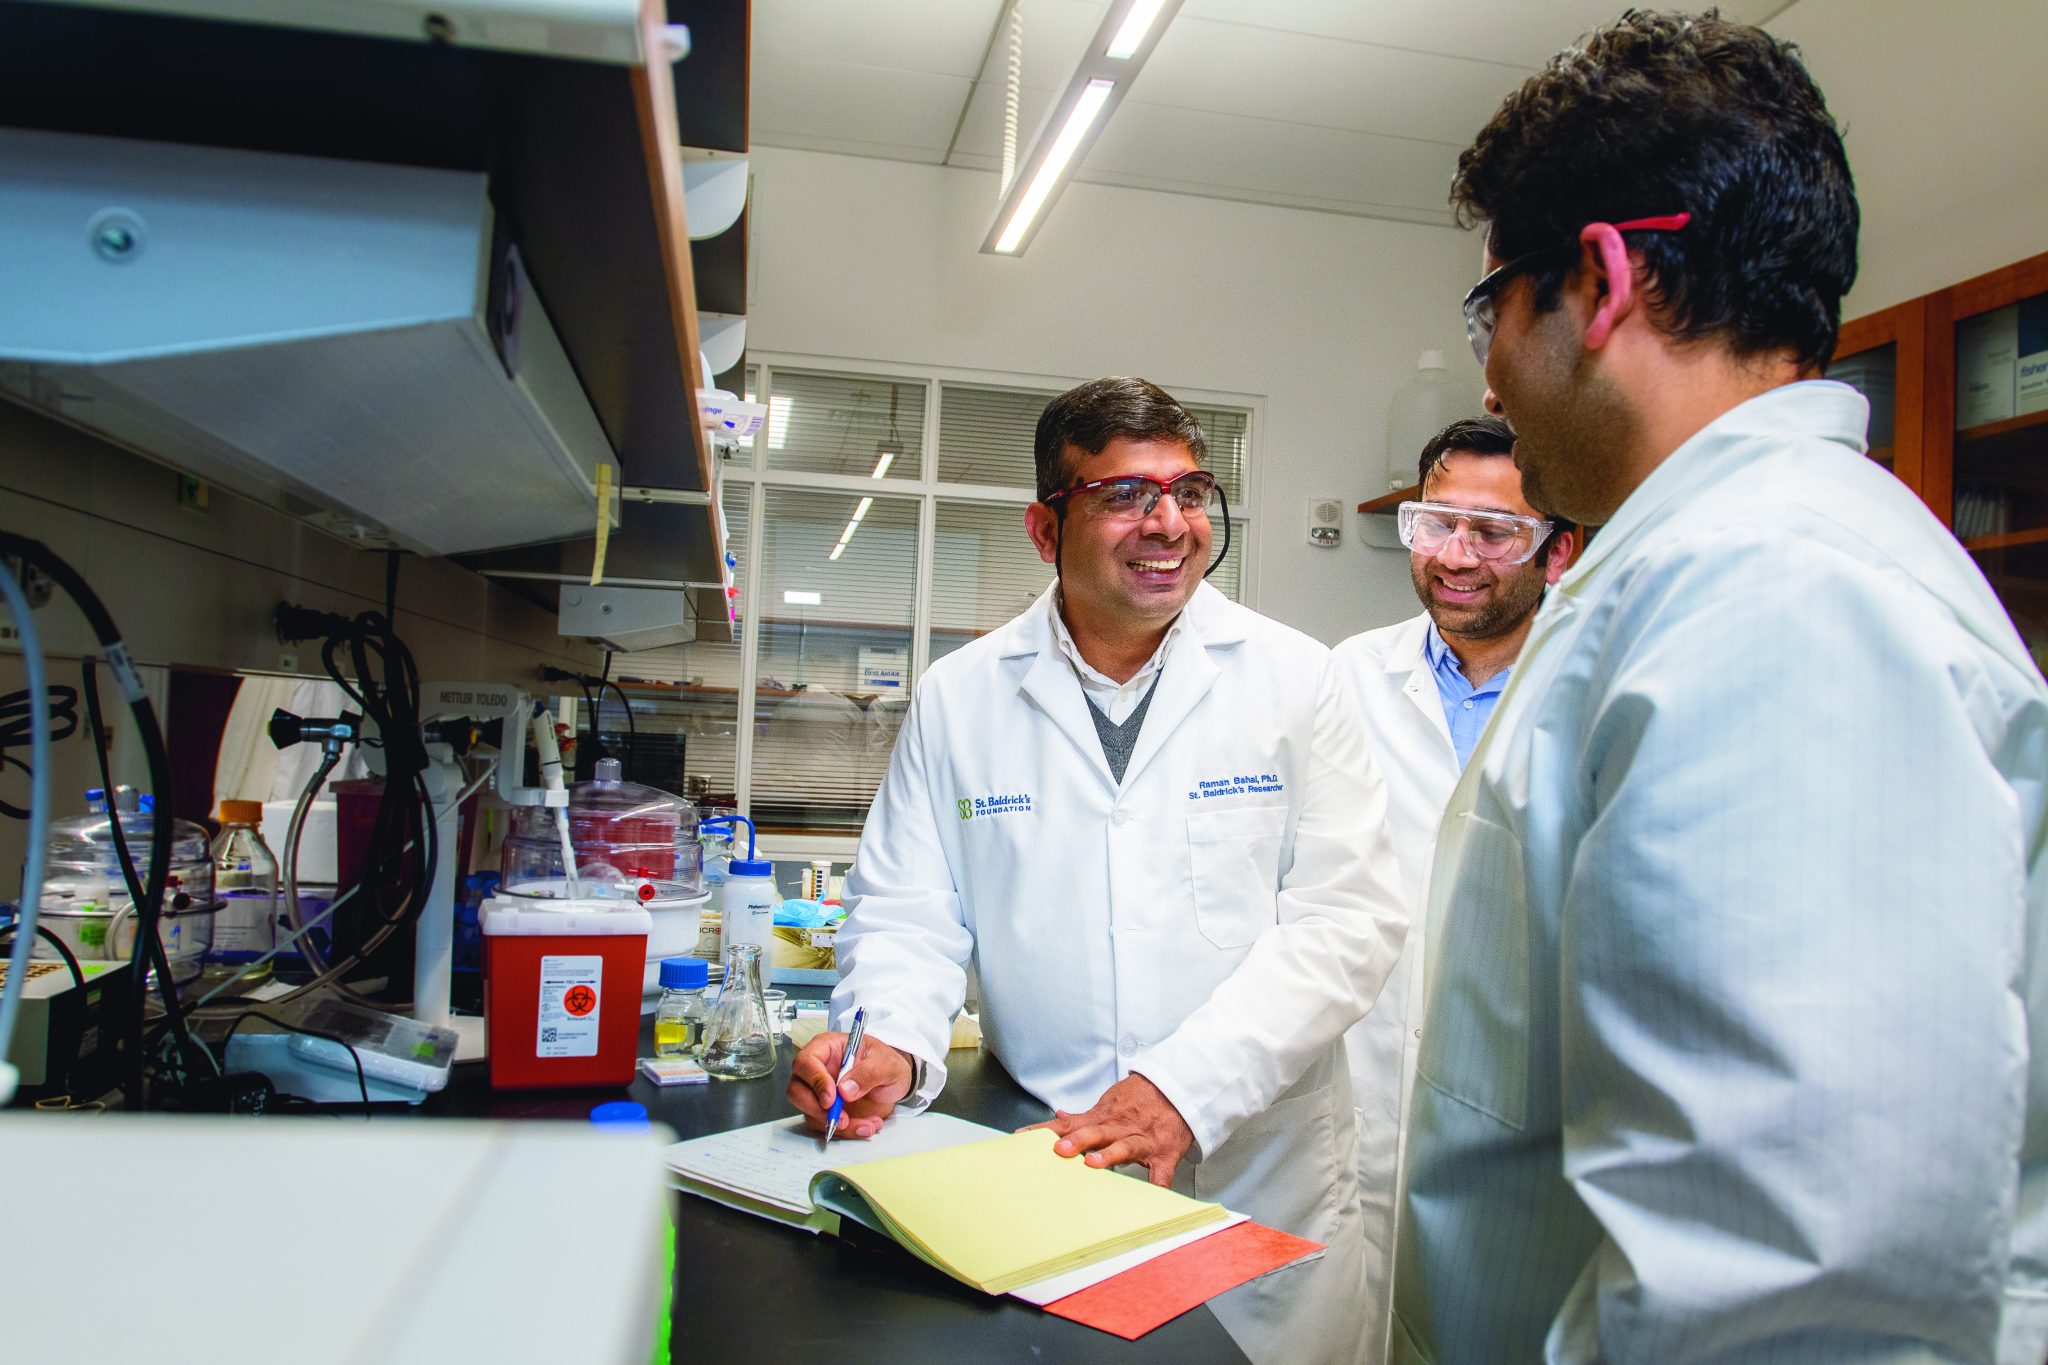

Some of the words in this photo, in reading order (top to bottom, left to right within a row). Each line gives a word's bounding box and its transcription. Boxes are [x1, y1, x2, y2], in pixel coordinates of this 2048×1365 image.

[703, 405, 722, 414] inge
[440, 690, 473, 705] METTLER
[476, 692, 508, 706] TOLEDO
[1199, 779, 1230, 789] Raman
[1188, 791, 1201, 800] St.
[1203, 785, 1245, 798] Baldrick's
[975, 798, 987, 808] St.
[988, 794, 1031, 806] Baldrick's
[975, 805, 1031, 816] FOUNDATION
